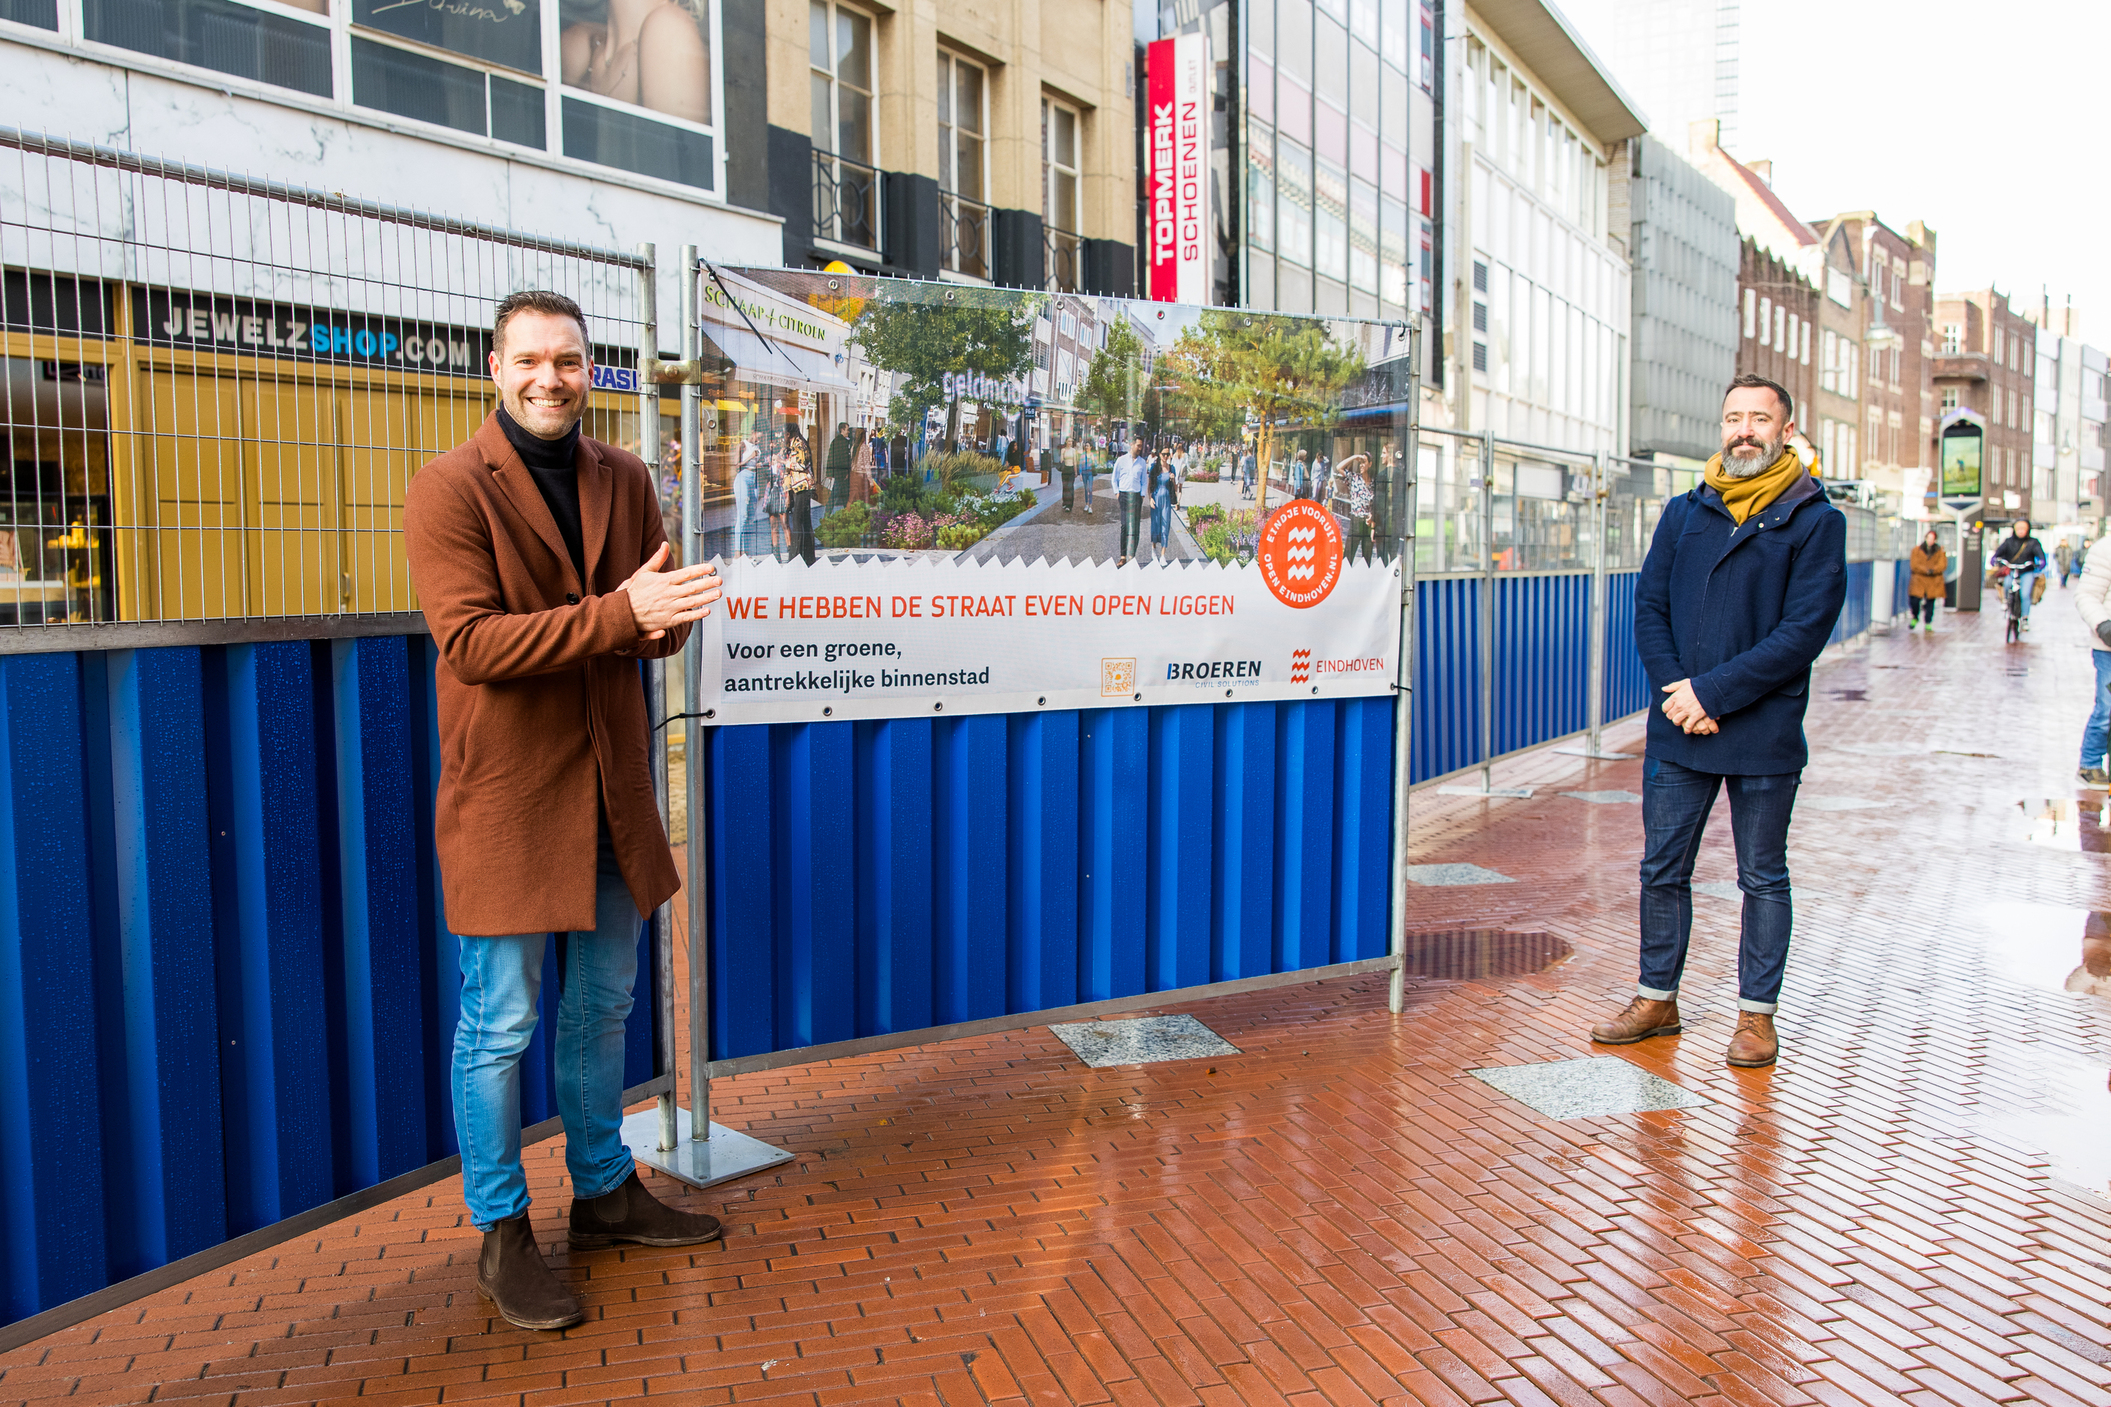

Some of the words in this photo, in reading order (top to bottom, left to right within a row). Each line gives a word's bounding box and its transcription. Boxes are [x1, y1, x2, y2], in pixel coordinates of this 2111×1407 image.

[1154, 101, 1175, 266] TOPMERK
[1182, 101, 1198, 262] SCHOENEN
[163, 306, 471, 367] JEWELZSHOP.COM
[1266, 506, 1299, 543] EINDJE
[1301, 505, 1337, 543] VOORUIT
[1264, 553, 1280, 587] OPEN
[1279, 553, 1338, 603] EINDHOVEN.NL
[726, 596, 769, 620] WE
[779, 596, 882, 619] HEBBEN
[892, 595, 922, 618] DE
[931, 595, 1016, 617] STRAAT
[1025, 595, 1083, 616] EVEN
[1092, 595, 1151, 616] OPEN
[1159, 595, 1235, 616] LIGGEN
[727, 643, 774, 660] Voor
[780, 643, 818, 658] een
[824, 643, 902, 663] groene,
[1316, 658, 1384, 673] EINDHOVEN
[724, 670, 875, 694] aantrekkelijke
[881, 666, 989, 688] binnenstad
[1167, 660, 1261, 680] BROEREN
[1195, 681, 1214, 689] CIVIL
[1217, 680, 1260, 688] SOLUTIONS
